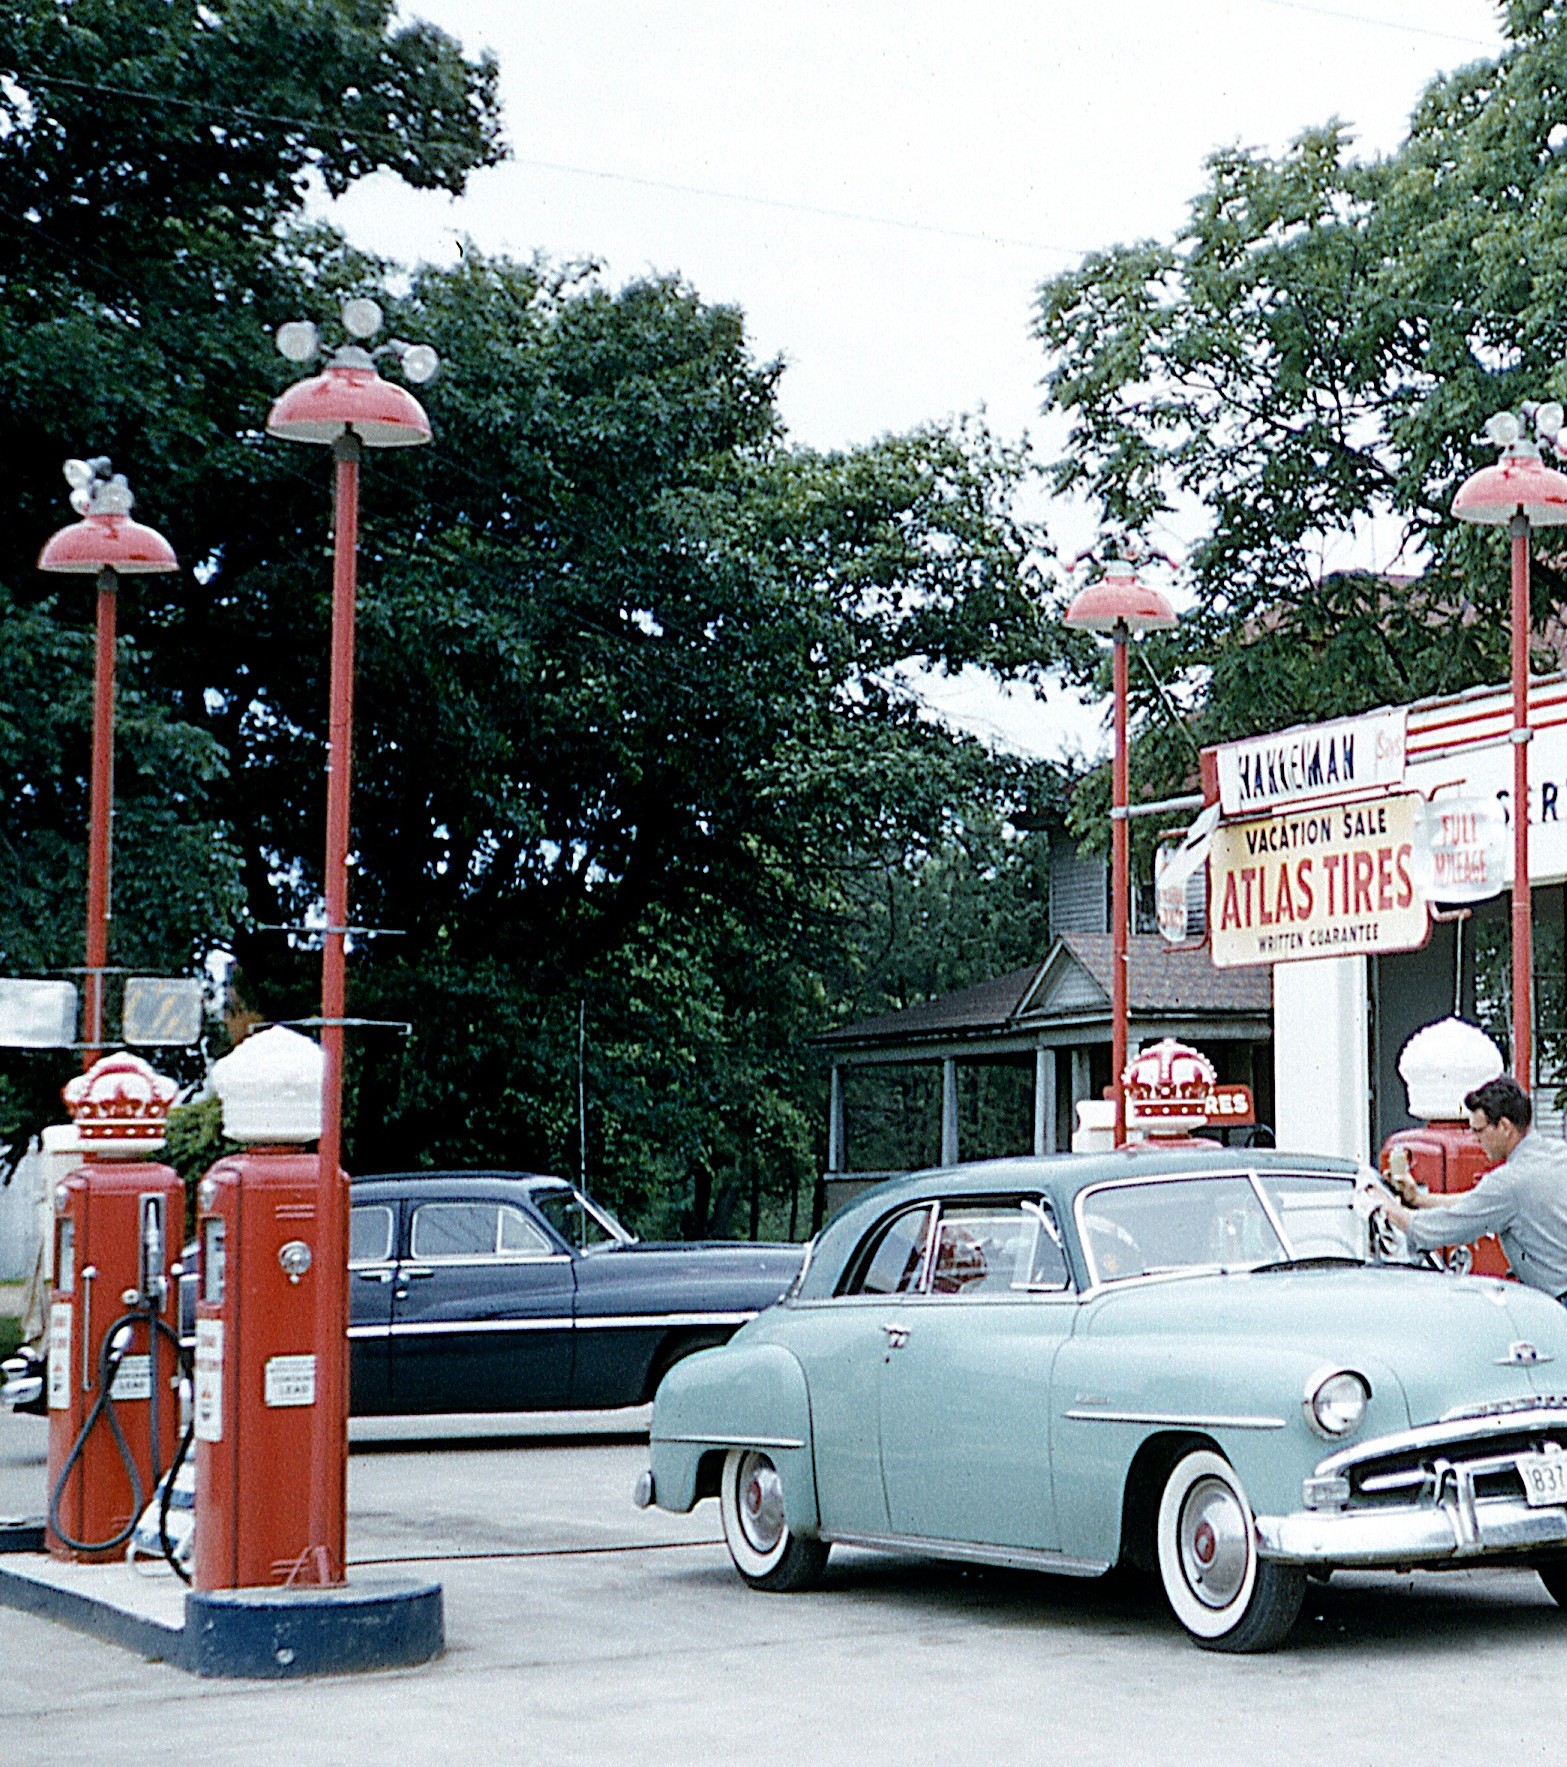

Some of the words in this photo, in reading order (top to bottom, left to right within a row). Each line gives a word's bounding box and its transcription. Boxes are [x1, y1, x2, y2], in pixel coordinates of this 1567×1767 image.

[1246, 818, 1331, 855] VACATION
[1343, 808, 1387, 839] SALE
[1440, 814, 1478, 846] FULL
[1220, 858, 1314, 931] ATLAS
[1323, 844, 1414, 917] TIRES
[1258, 933, 1303, 952] WRITTEN
[1310, 923, 1379, 946] GUARANTEE
